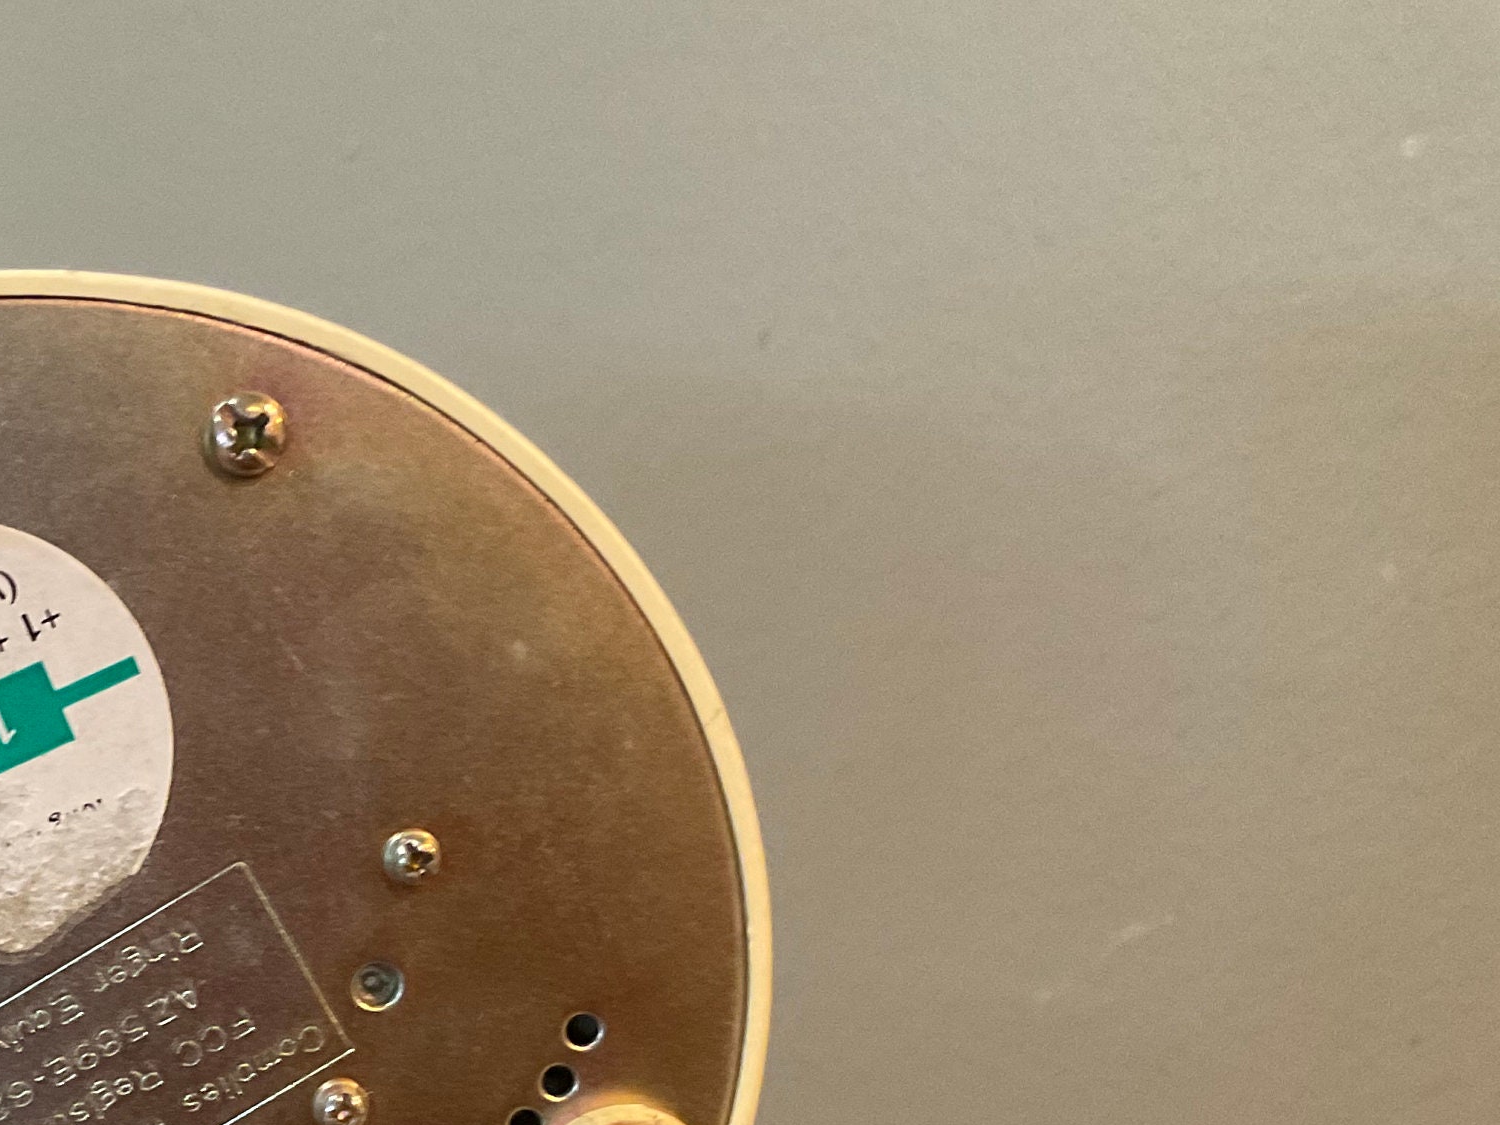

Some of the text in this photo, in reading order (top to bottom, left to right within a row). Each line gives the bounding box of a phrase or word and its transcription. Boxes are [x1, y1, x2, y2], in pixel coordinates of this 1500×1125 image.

[21, 608, 61, 642] +1
[93, 931, 204, 993] Ringer
[175, 1007, 256, 1068] FCC
[181, 1023, 326, 1113] Complies
